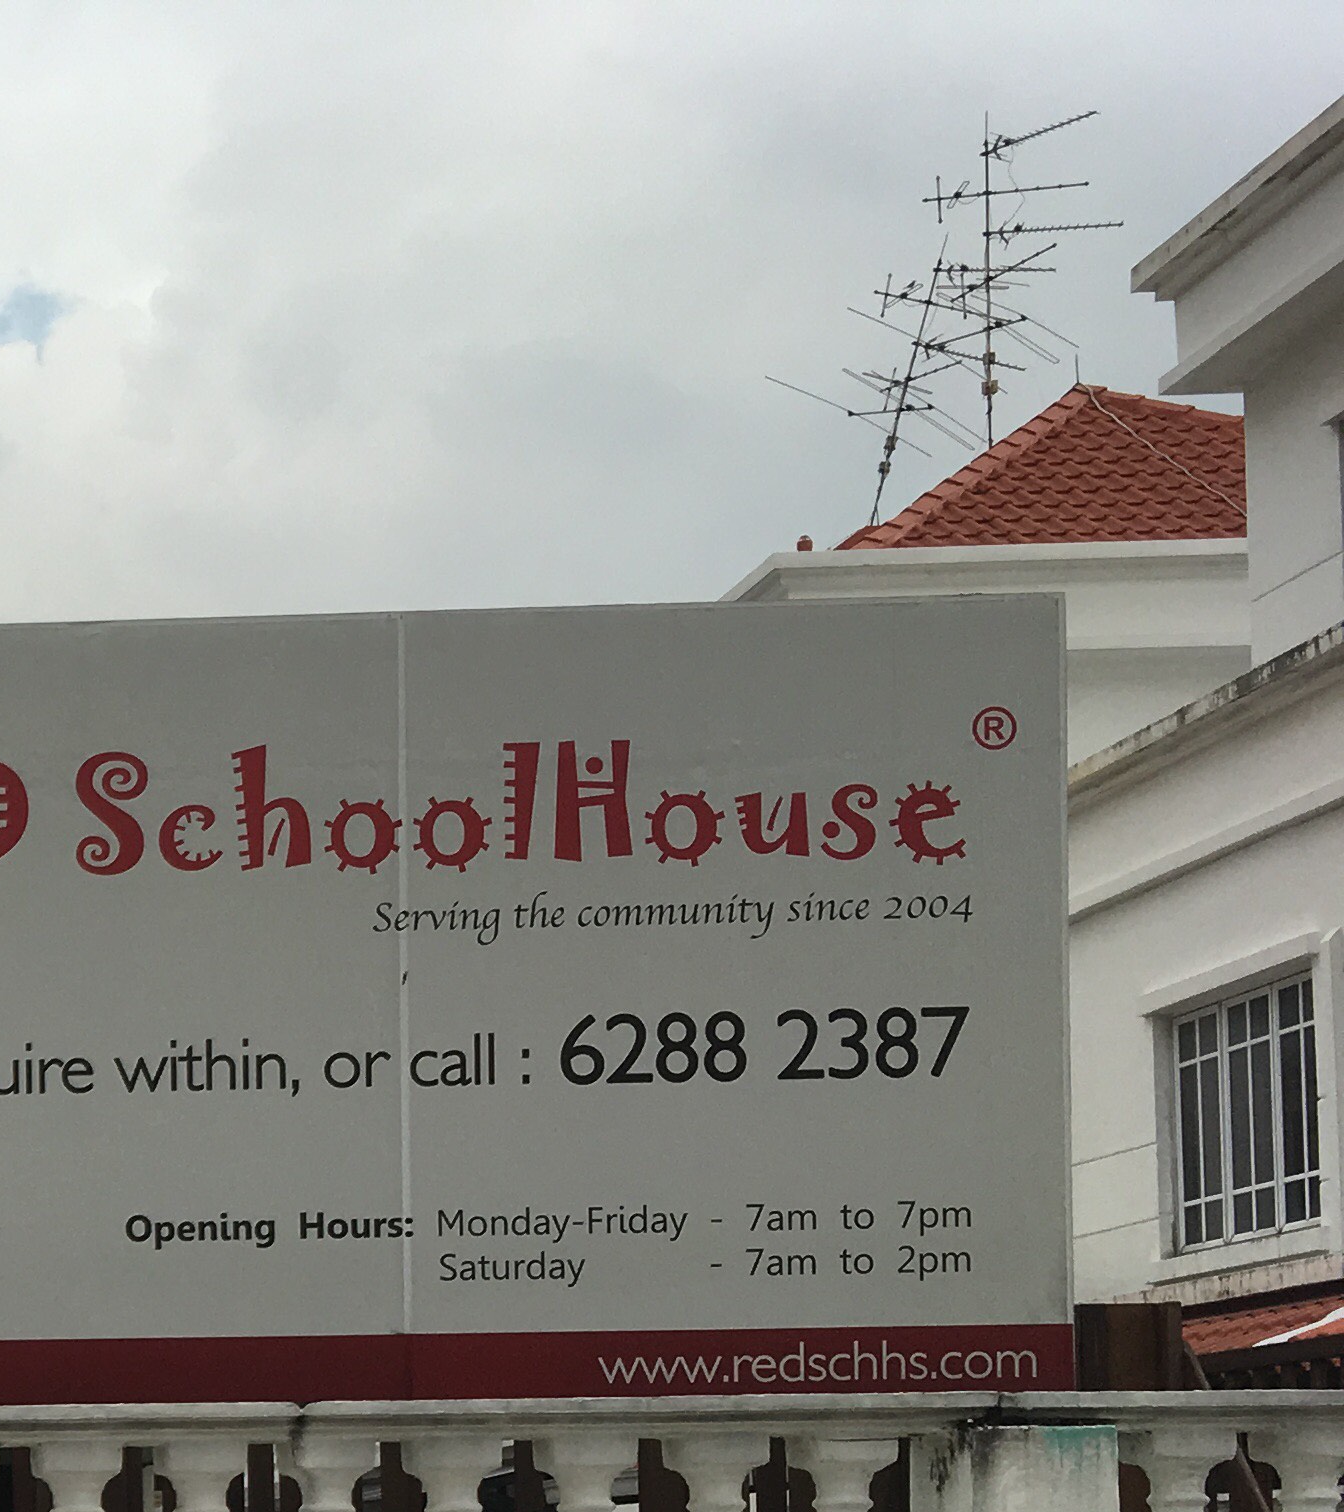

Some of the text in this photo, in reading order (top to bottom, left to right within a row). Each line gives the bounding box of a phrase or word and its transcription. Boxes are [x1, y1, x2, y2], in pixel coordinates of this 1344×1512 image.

[76, 739, 964, 875] SchoolHouse
[373, 891, 973, 945] Serving the community since 2004
[114, 1038, 299, 1097] within,
[324, 1051, 391, 1088] or
[410, 1033, 495, 1087] call
[561, 1011, 747, 1085] 6288
[777, 1007, 970, 1080] 2387
[125, 1213, 276, 1249] Opening
[300, 1212, 414, 1239] Hours:
[438, 1205, 688, 1243] Monday-Friday
[746, 1204, 816, 1231] 7am
[840, 1205, 874, 1229] to
[898, 1201, 971, 1236] 7pm
[440, 1251, 585, 1287] Saturday
[746, 1249, 816, 1276] 7am
[840, 1249, 873, 1274] to
[898, 1246, 971, 1281] 2pm
[598, 1340, 1039, 1387] www.redschhs.com
